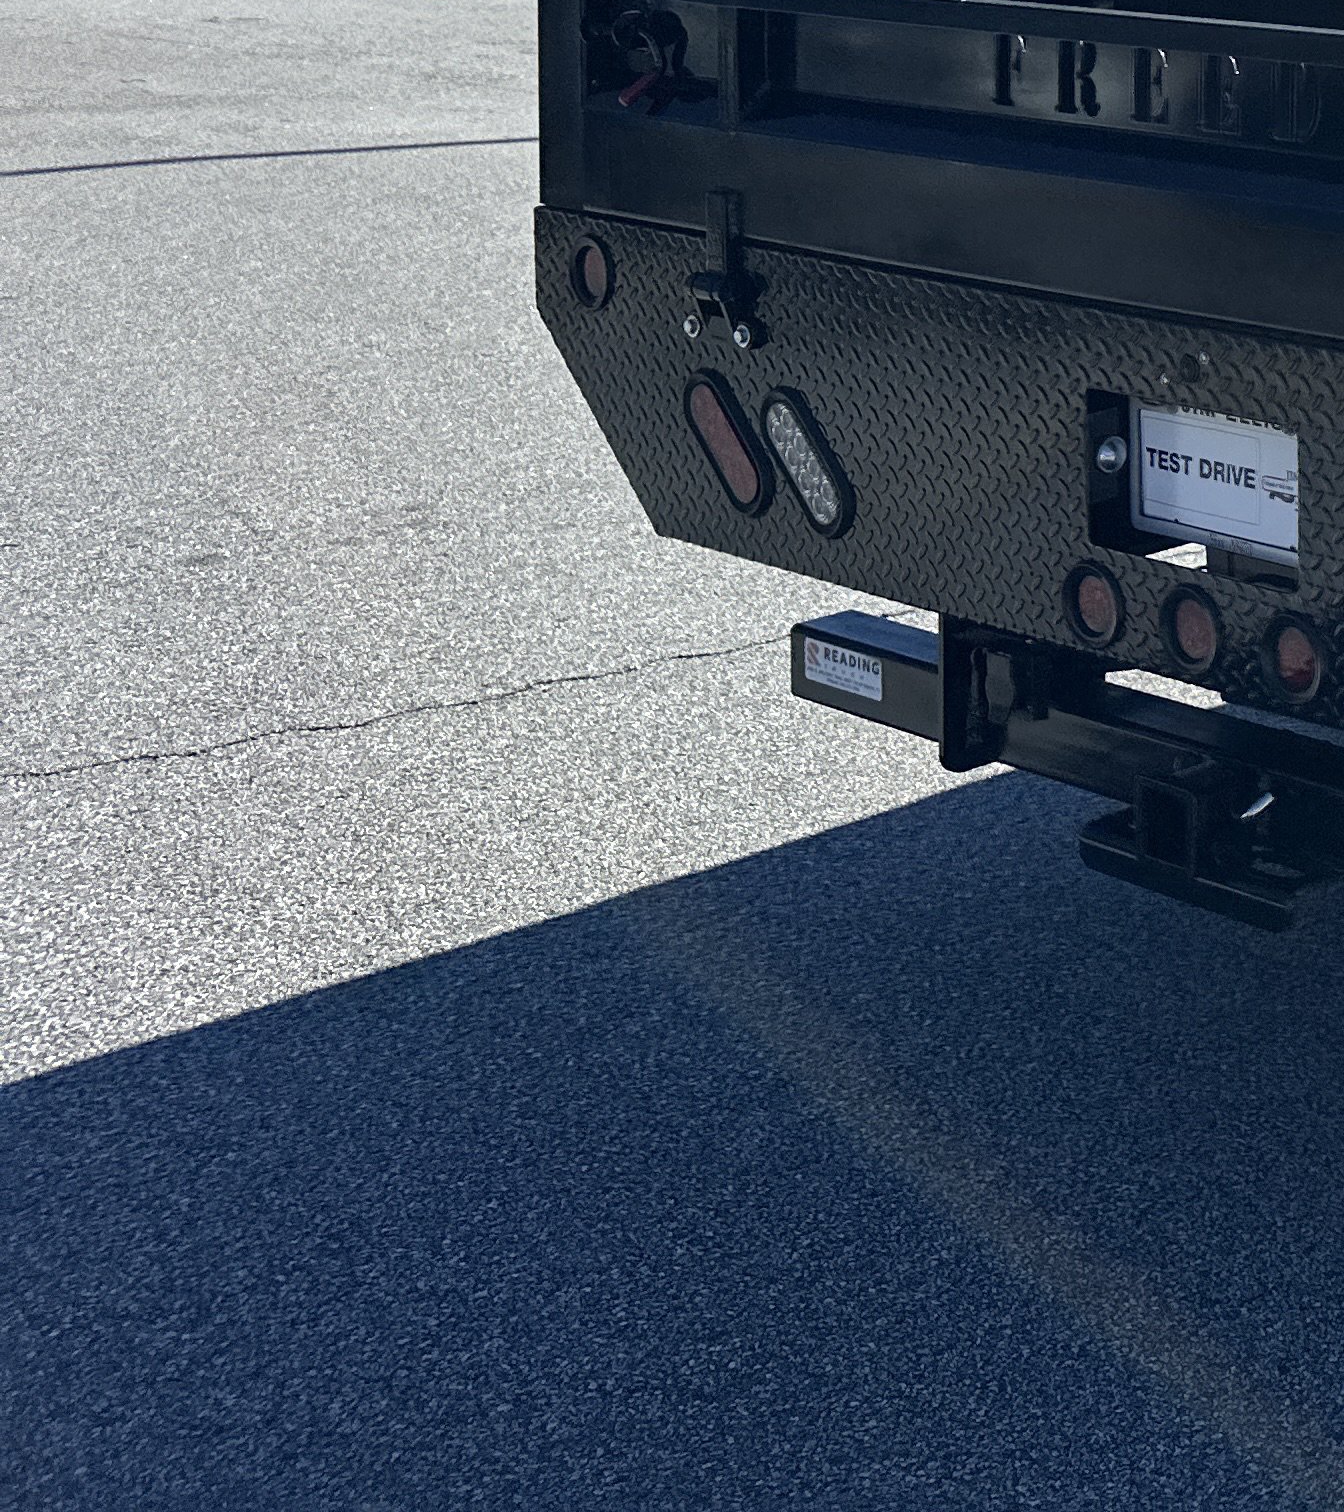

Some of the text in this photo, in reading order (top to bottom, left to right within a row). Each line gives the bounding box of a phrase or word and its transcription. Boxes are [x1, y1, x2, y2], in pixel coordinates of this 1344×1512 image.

[1146, 446, 1256, 489] TEST DRIVE
[824, 647, 880, 675] READING
